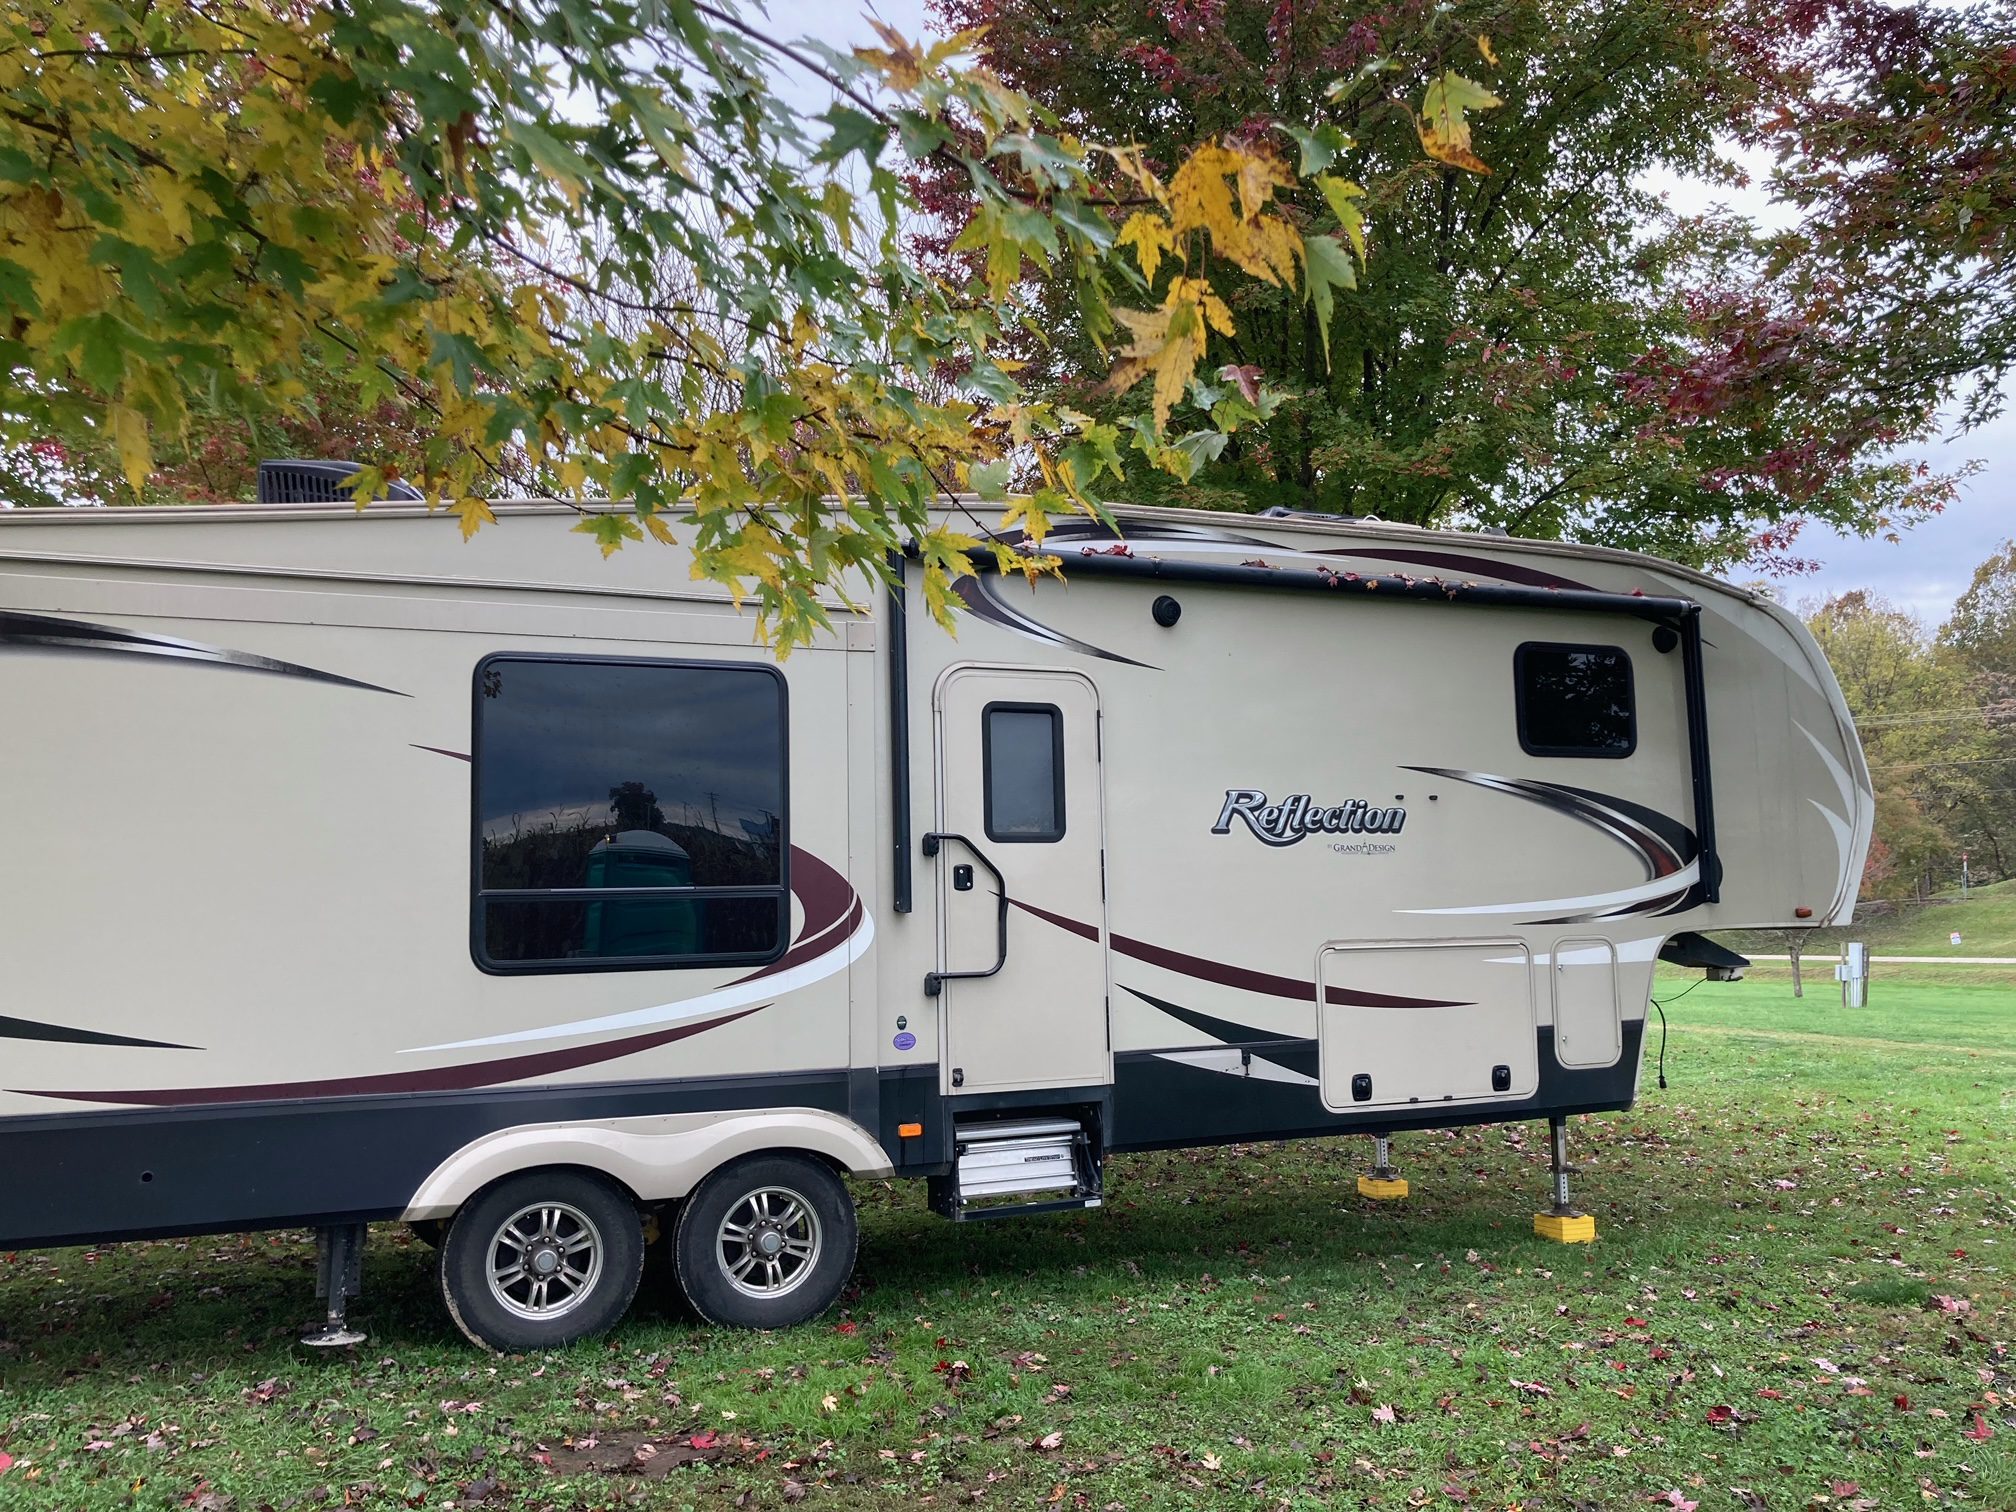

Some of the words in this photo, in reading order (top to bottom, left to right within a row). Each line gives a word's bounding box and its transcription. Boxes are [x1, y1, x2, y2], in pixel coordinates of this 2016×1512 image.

[1210, 789, 1407, 847] Reflection
[1333, 843, 1362, 852] GRAND
[1368, 843, 1396, 852] DESIGN
